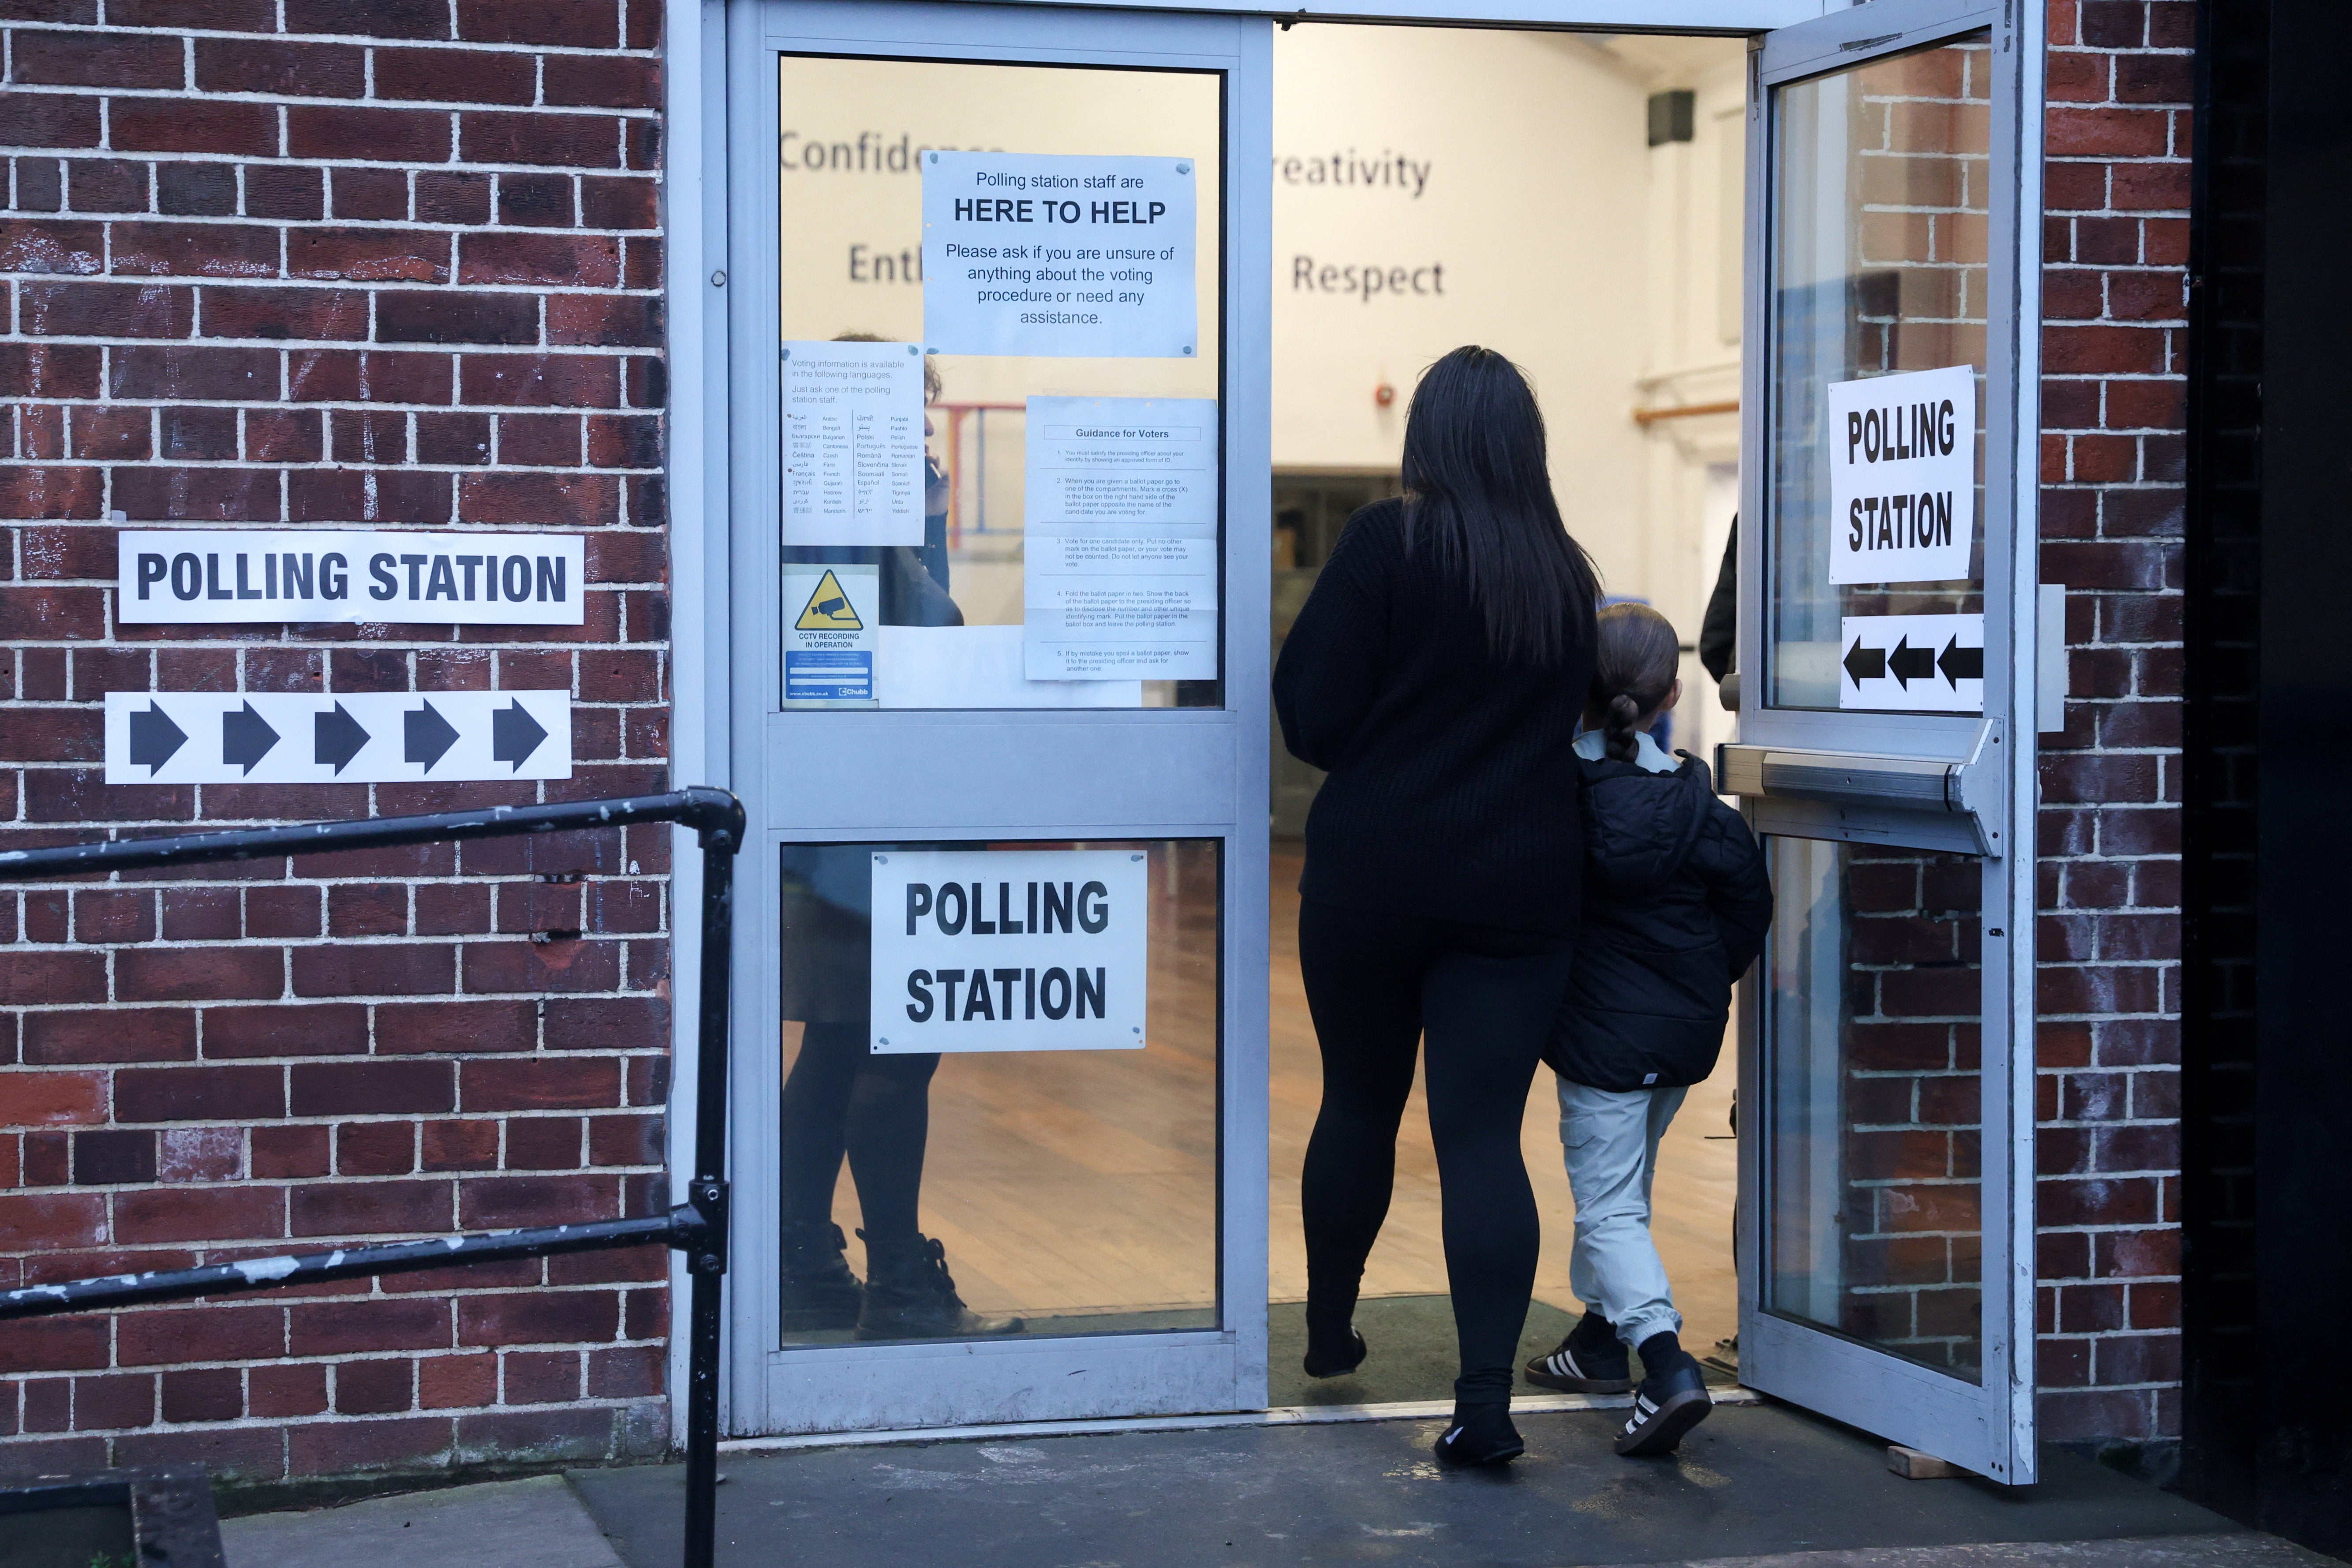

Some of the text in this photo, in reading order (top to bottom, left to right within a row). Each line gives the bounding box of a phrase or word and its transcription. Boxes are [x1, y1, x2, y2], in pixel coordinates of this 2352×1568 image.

[977, 172, 1143, 190] Polling station staff are
[955, 198, 1165, 224] HERE TO HELP
[946, 243, 1174, 262] Please ask if you are unsure of
[968, 266, 1152, 284] anything about the voting
[1292, 254, 1445, 302] Respect
[978, 288, 1144, 306] procedure or need any
[1020, 310, 1102, 324] assistance.
[792, 359, 815, 369] Voting
[818, 359, 859, 368] information
[815, 370, 847, 379] following
[850, 370, 892, 380] languages.
[865, 386, 890, 395] polling
[1076, 429, 1120, 437] Guidance
[1138, 429, 1169, 438] Voters
[1848, 399, 1954, 464] POLLING
[1849, 491, 1952, 552] STATION
[138, 552, 565, 602] POLLING STATION
[906, 881, 1108, 936] POLLING
[906, 967, 1106, 1023] STATION
